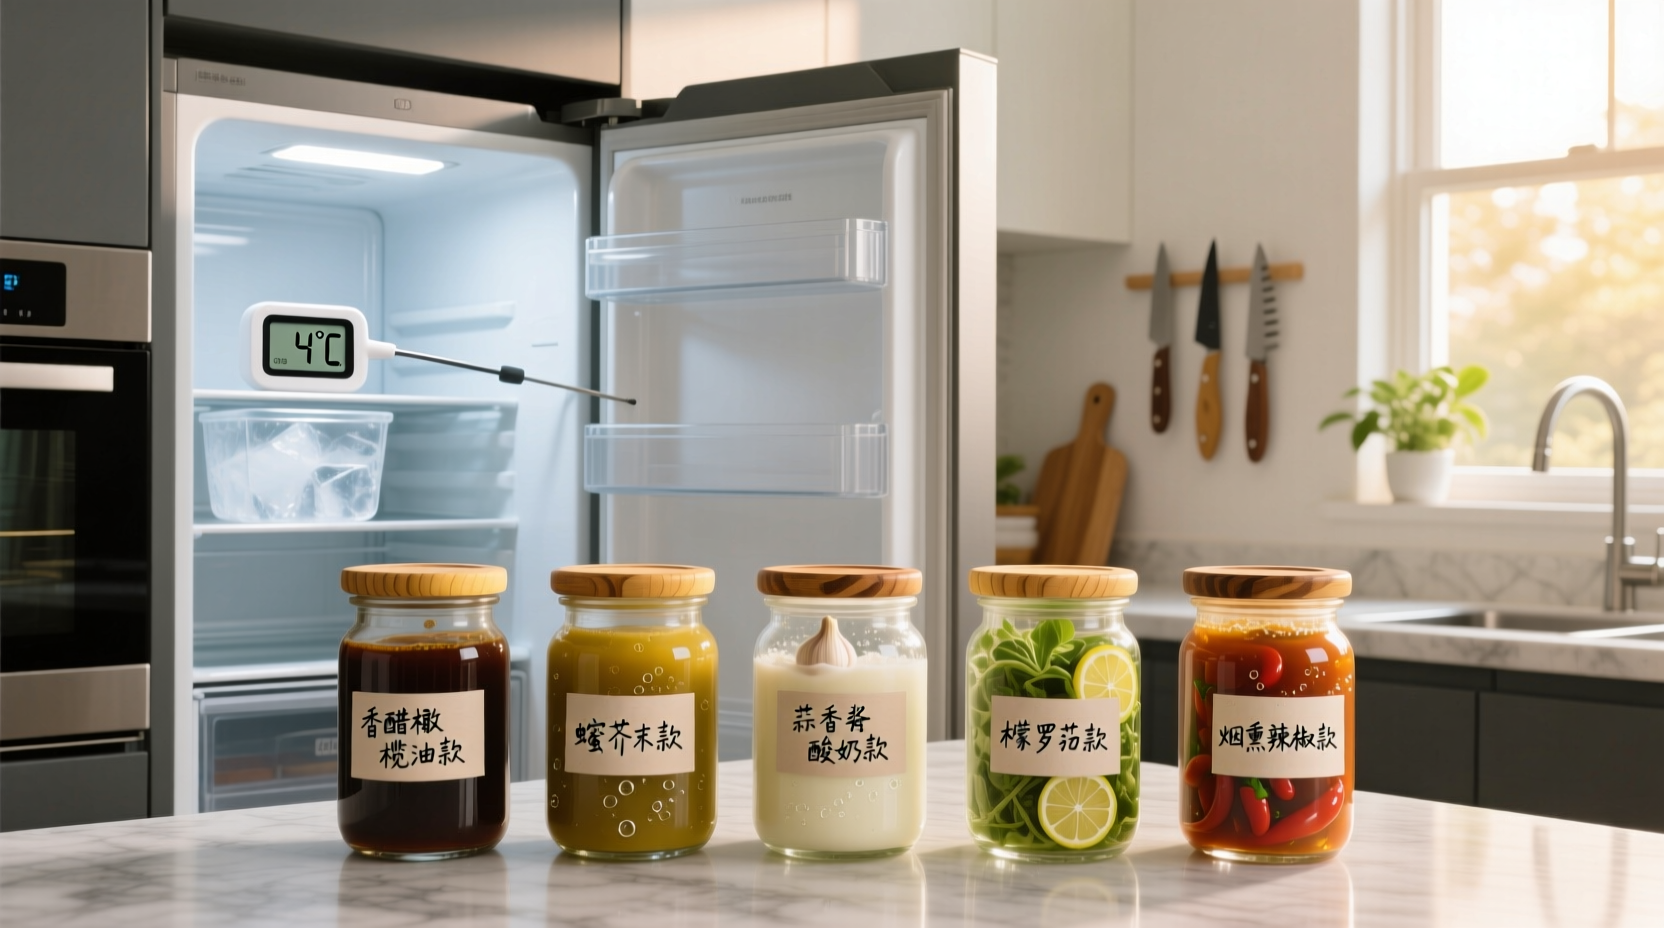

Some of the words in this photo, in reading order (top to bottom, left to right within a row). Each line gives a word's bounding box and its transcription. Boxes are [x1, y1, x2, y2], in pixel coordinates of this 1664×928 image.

[361, 706, 444, 738] 香醋橄
[1218, 721, 1338, 753] 烟熏辣椒款
[379, 736, 466, 769] 榄油款
[808, 733, 889, 765] 酸奶款
